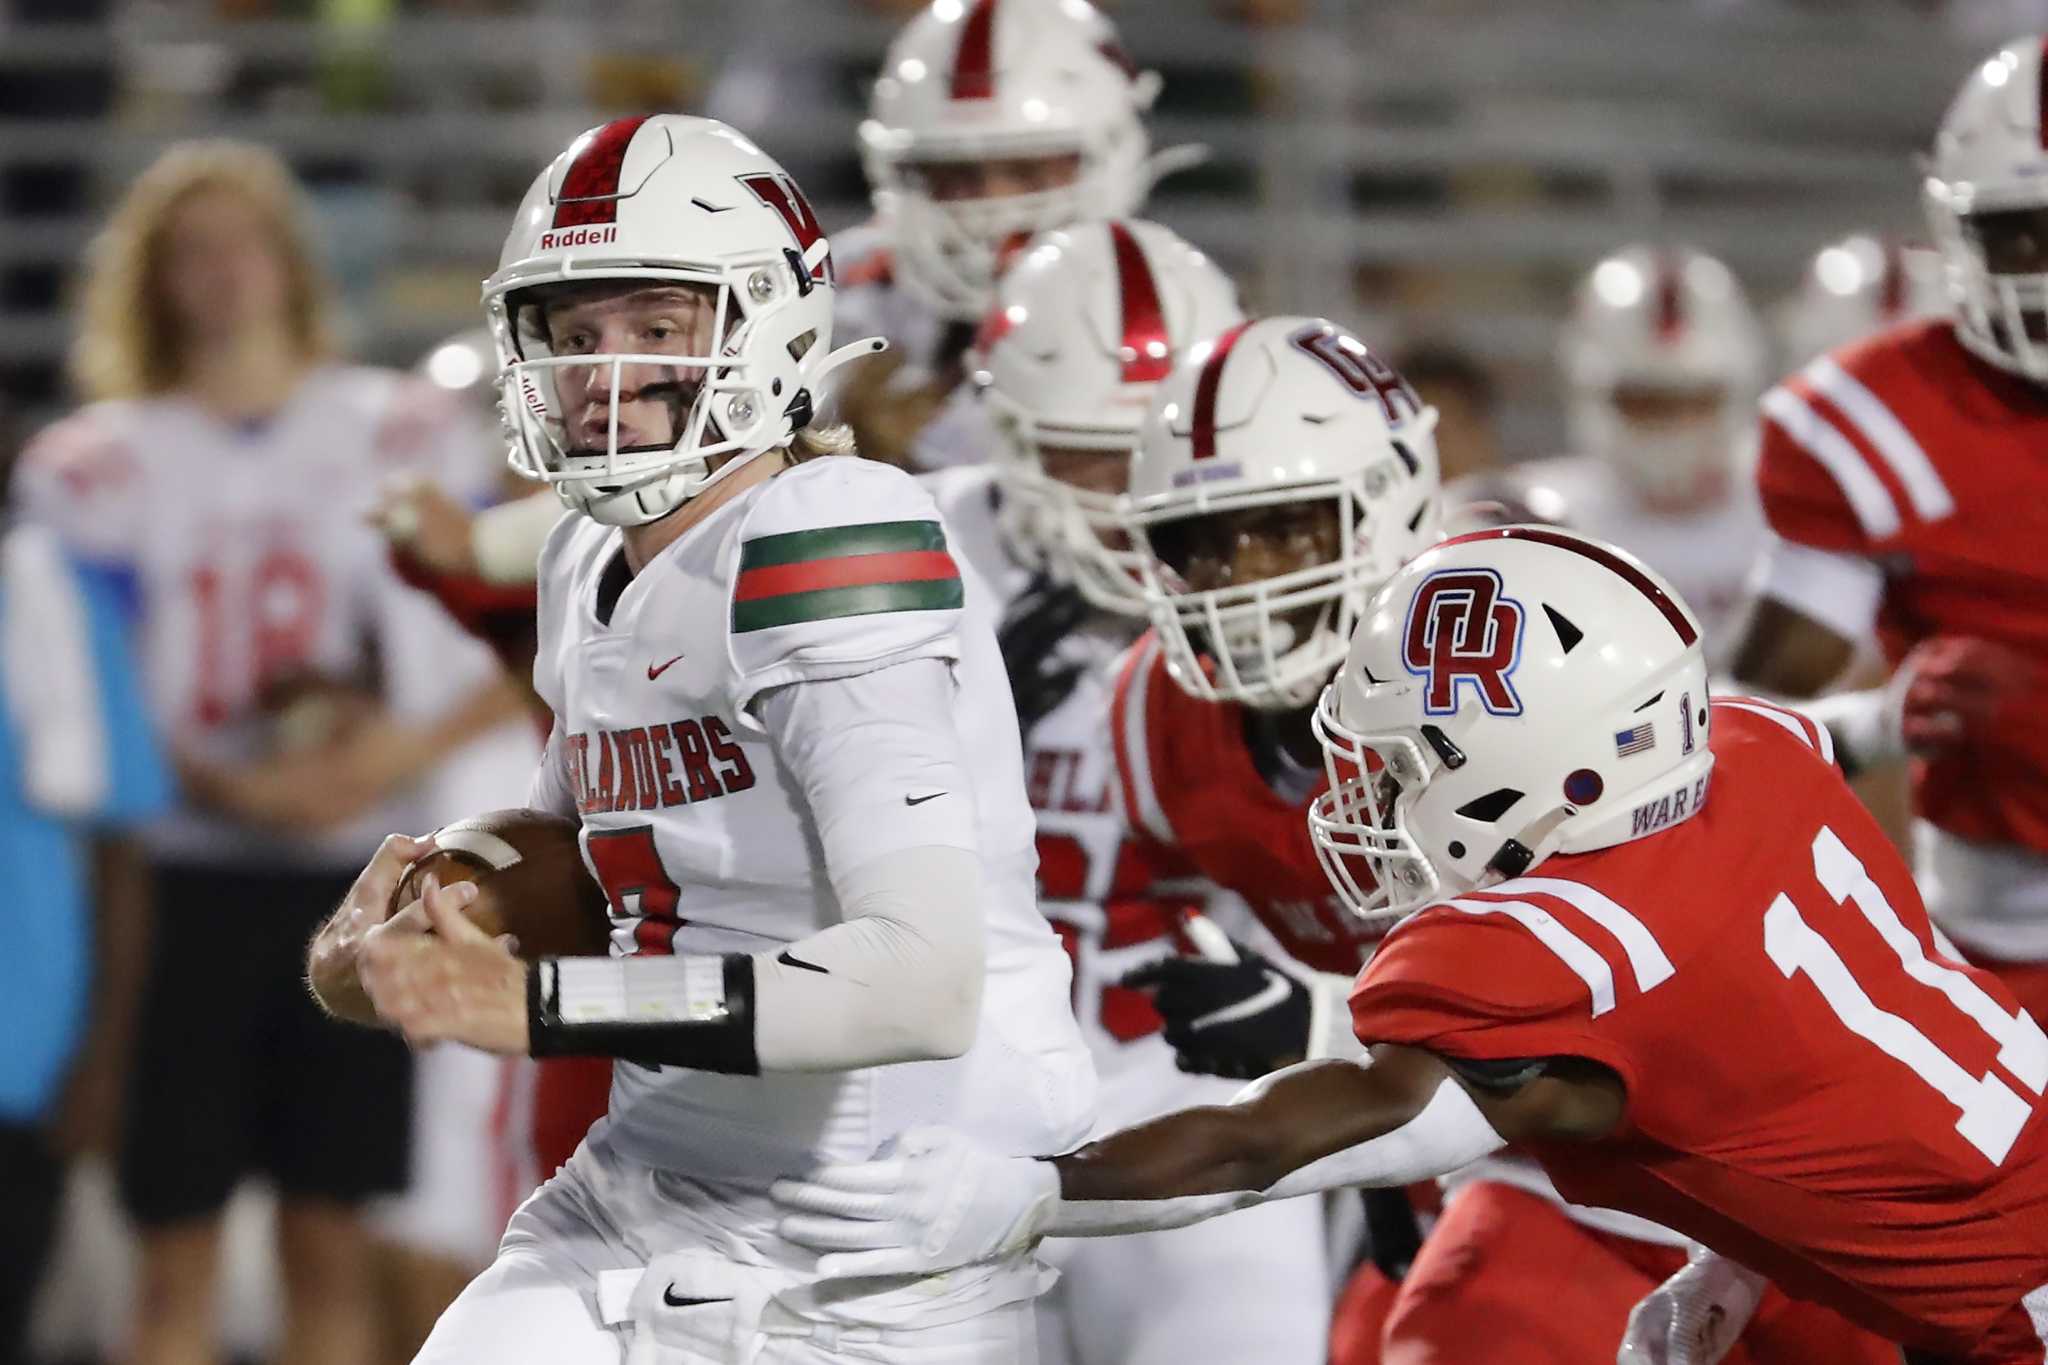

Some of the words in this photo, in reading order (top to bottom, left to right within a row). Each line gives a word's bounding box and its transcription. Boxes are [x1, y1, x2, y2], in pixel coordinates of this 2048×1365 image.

[541, 227, 616, 250] Riddell
[1402, 567, 1525, 716] OR
[1763, 824, 2048, 1167] 11
